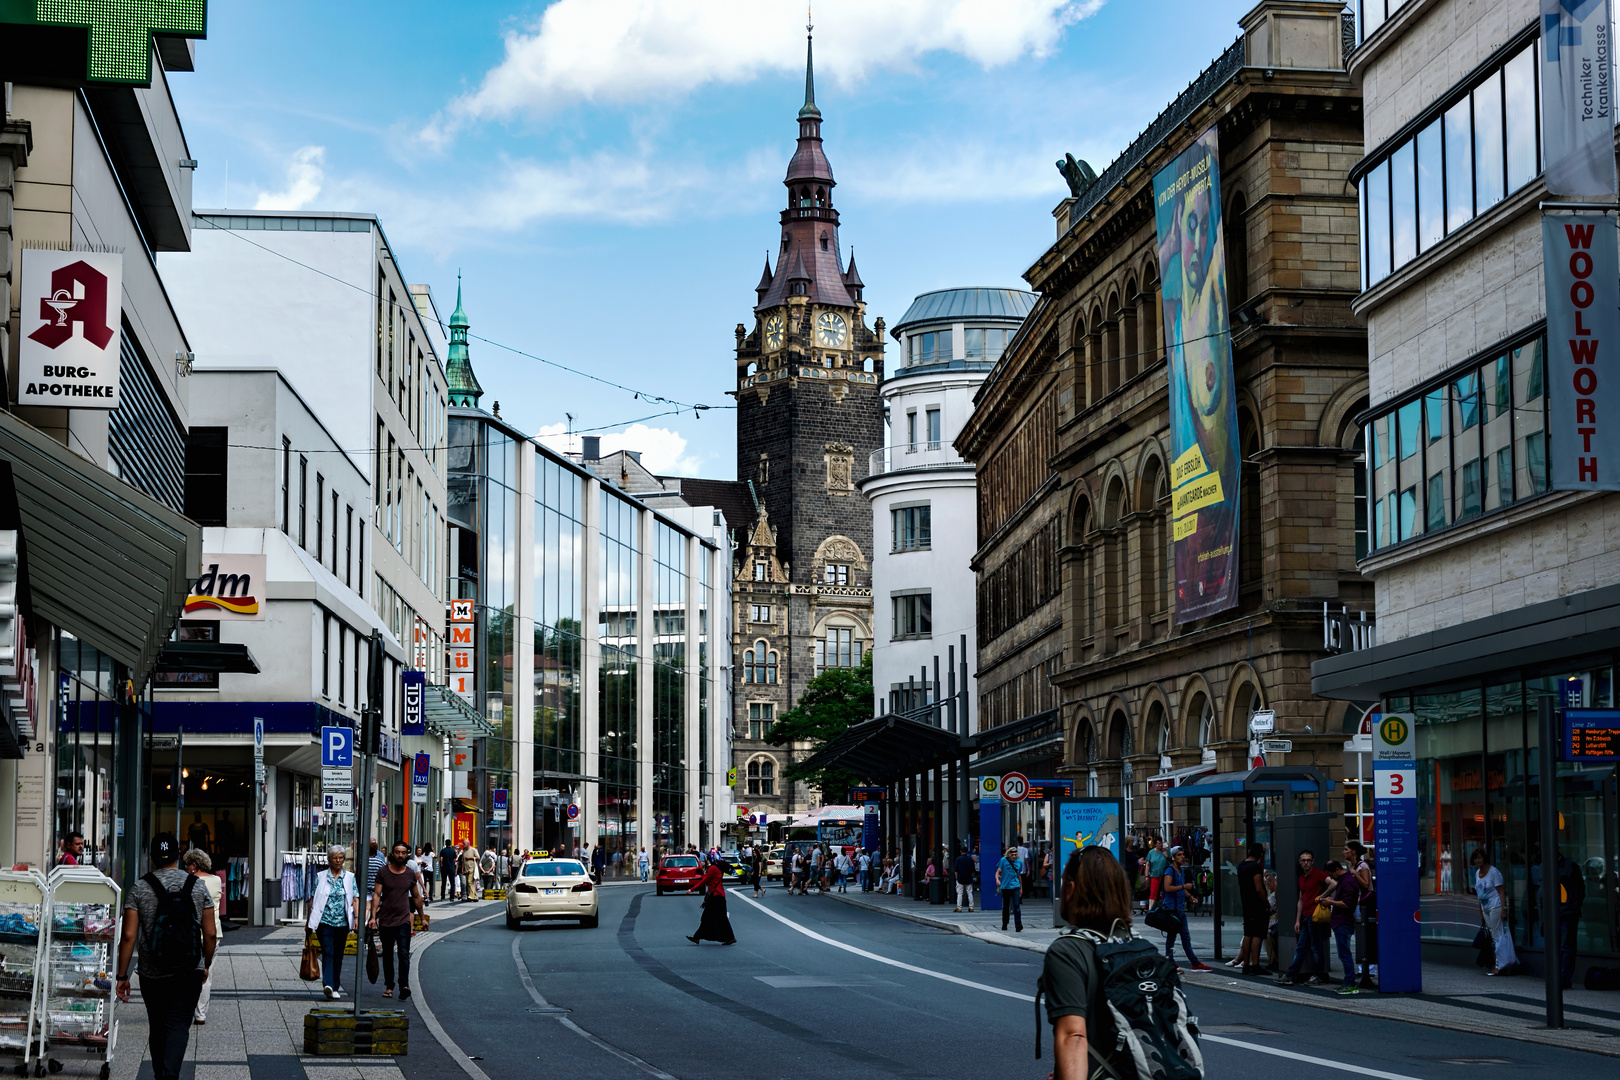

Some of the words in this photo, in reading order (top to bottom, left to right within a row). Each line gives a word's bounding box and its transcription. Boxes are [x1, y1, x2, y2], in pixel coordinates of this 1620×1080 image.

[1596, 24, 1609, 118] Krankenkasse
[1580, 57, 1593, 122] Techniker
[1565, 224, 1599, 482] WOOLWORTH
[43, 365, 96, 378] BURG-
[25, 383, 114, 398] APOTHEKE
[195, 564, 251, 597] dm
[456, 606, 468, 616] M
[407, 682, 419, 724] CECIL
[1388, 723, 1400, 739] H
[36, 742, 44, 752] a
[329, 732, 346, 761] P
[415, 775, 428, 783] TAXI
[1390, 773, 1404, 795] 3
[1007, 780, 1023, 794] 20
[339, 799, 350, 807] Std.
[457, 821, 470, 831] FINAL
[458, 831, 469, 840] SALE
